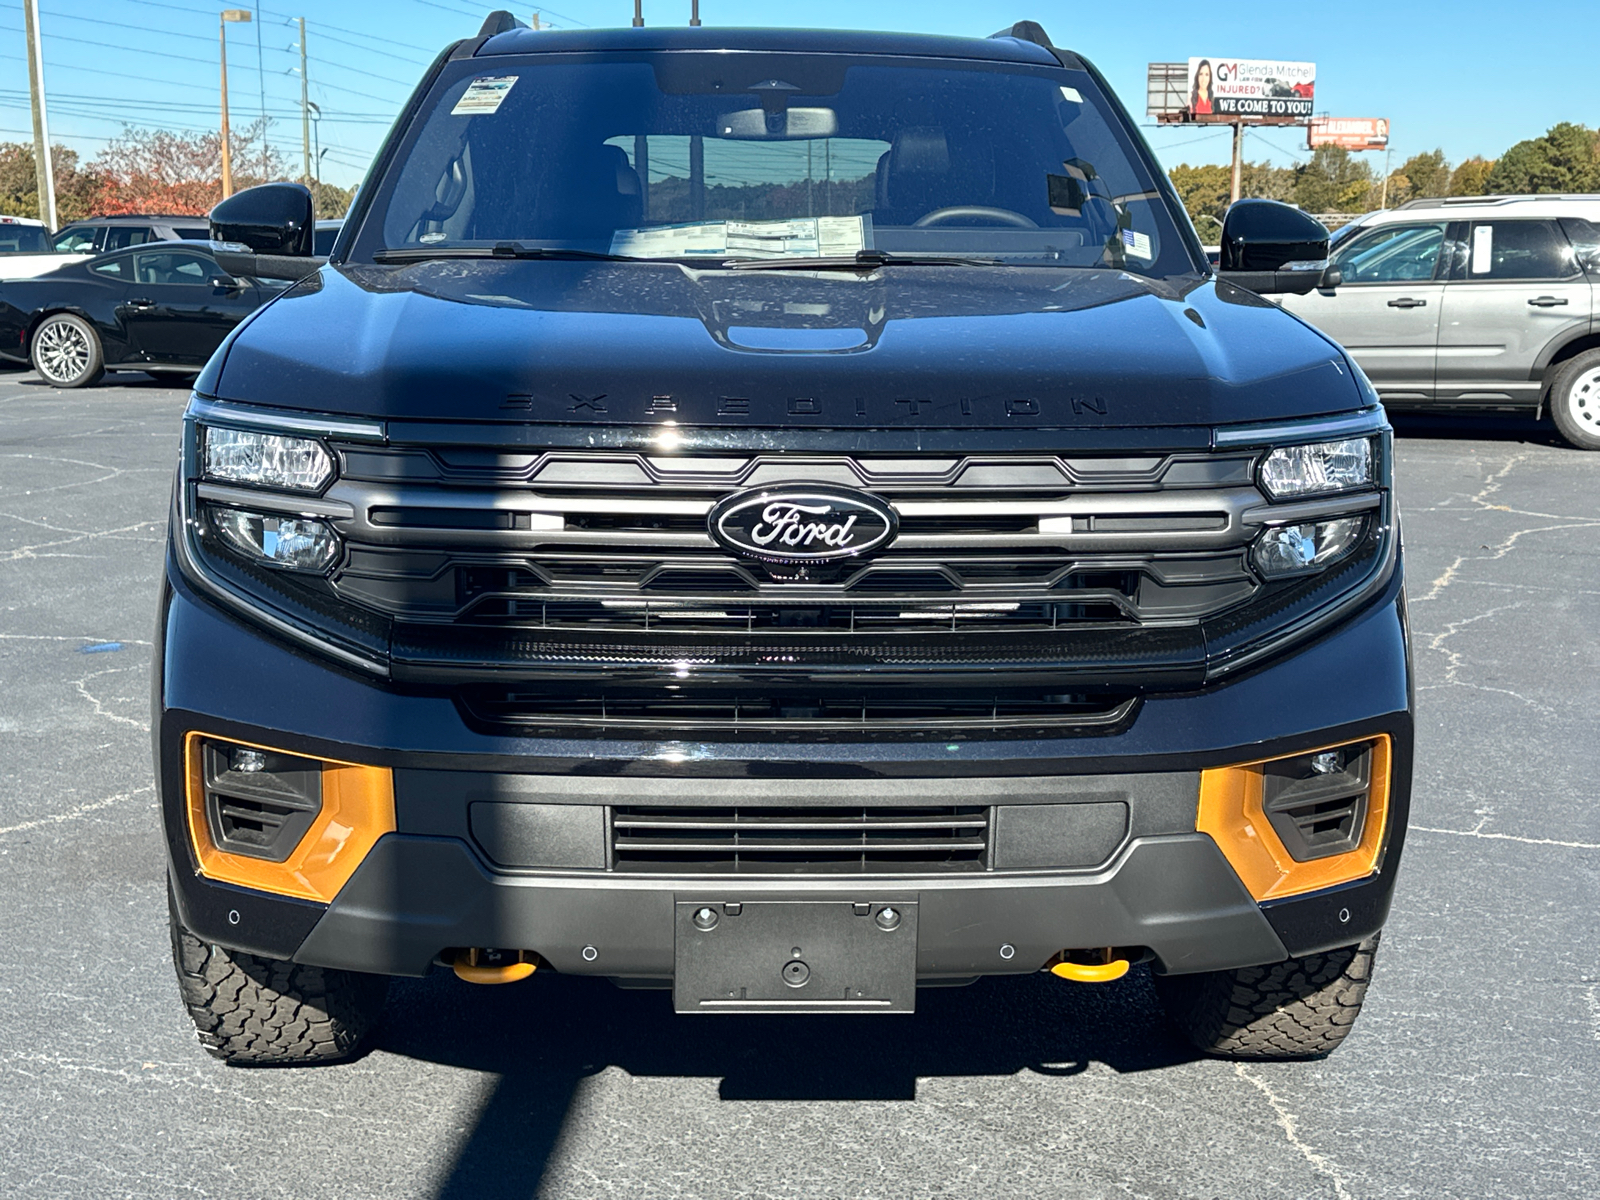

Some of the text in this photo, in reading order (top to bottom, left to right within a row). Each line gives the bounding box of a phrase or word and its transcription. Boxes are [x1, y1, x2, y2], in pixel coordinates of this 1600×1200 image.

[1217, 63, 1238, 81] GM
[1239, 63, 1314, 78] Glenda Mitchell
[1217, 85, 1260, 94] INJURED?
[1219, 99, 1312, 114] WE COME TO YOU!
[751, 502, 857, 547] Ford
